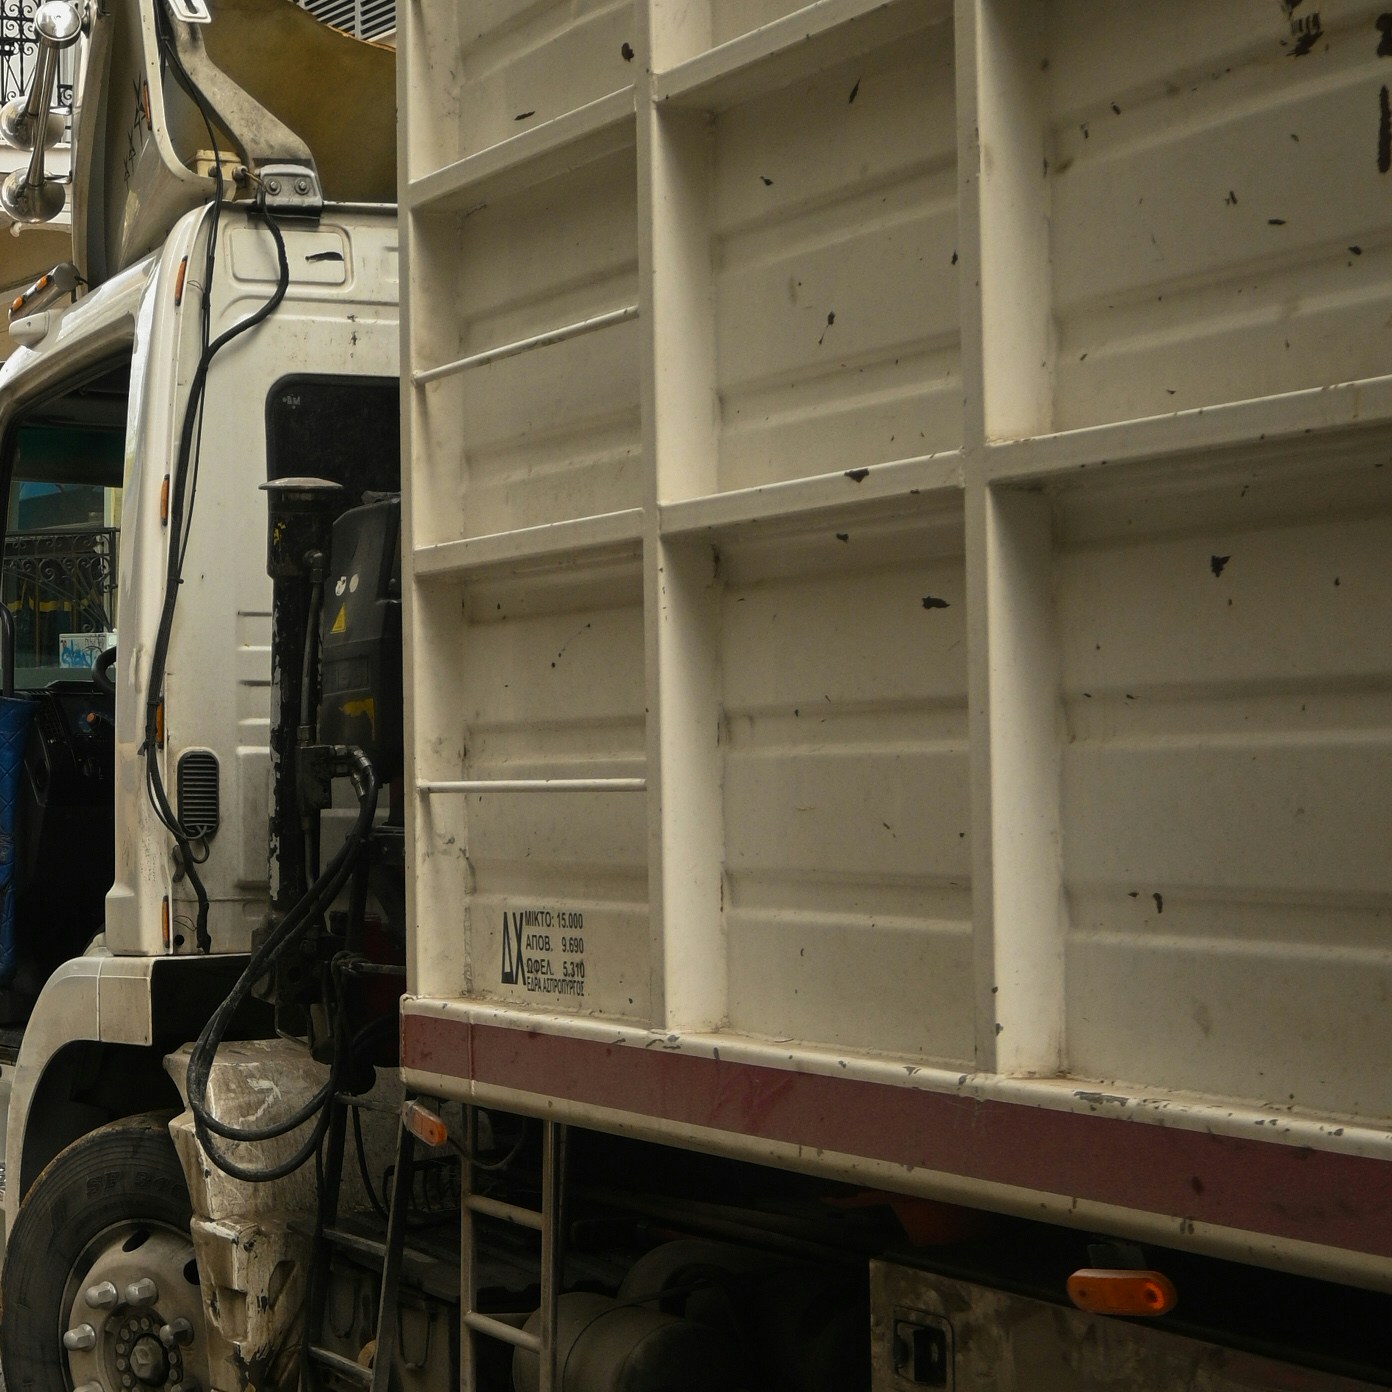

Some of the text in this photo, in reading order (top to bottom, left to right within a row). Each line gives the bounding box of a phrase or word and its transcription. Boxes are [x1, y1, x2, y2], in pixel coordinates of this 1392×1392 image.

[557, 912, 583, 929] 15.000
[561, 936, 584, 954] 9.690
[563, 960, 585, 979] 5.310
